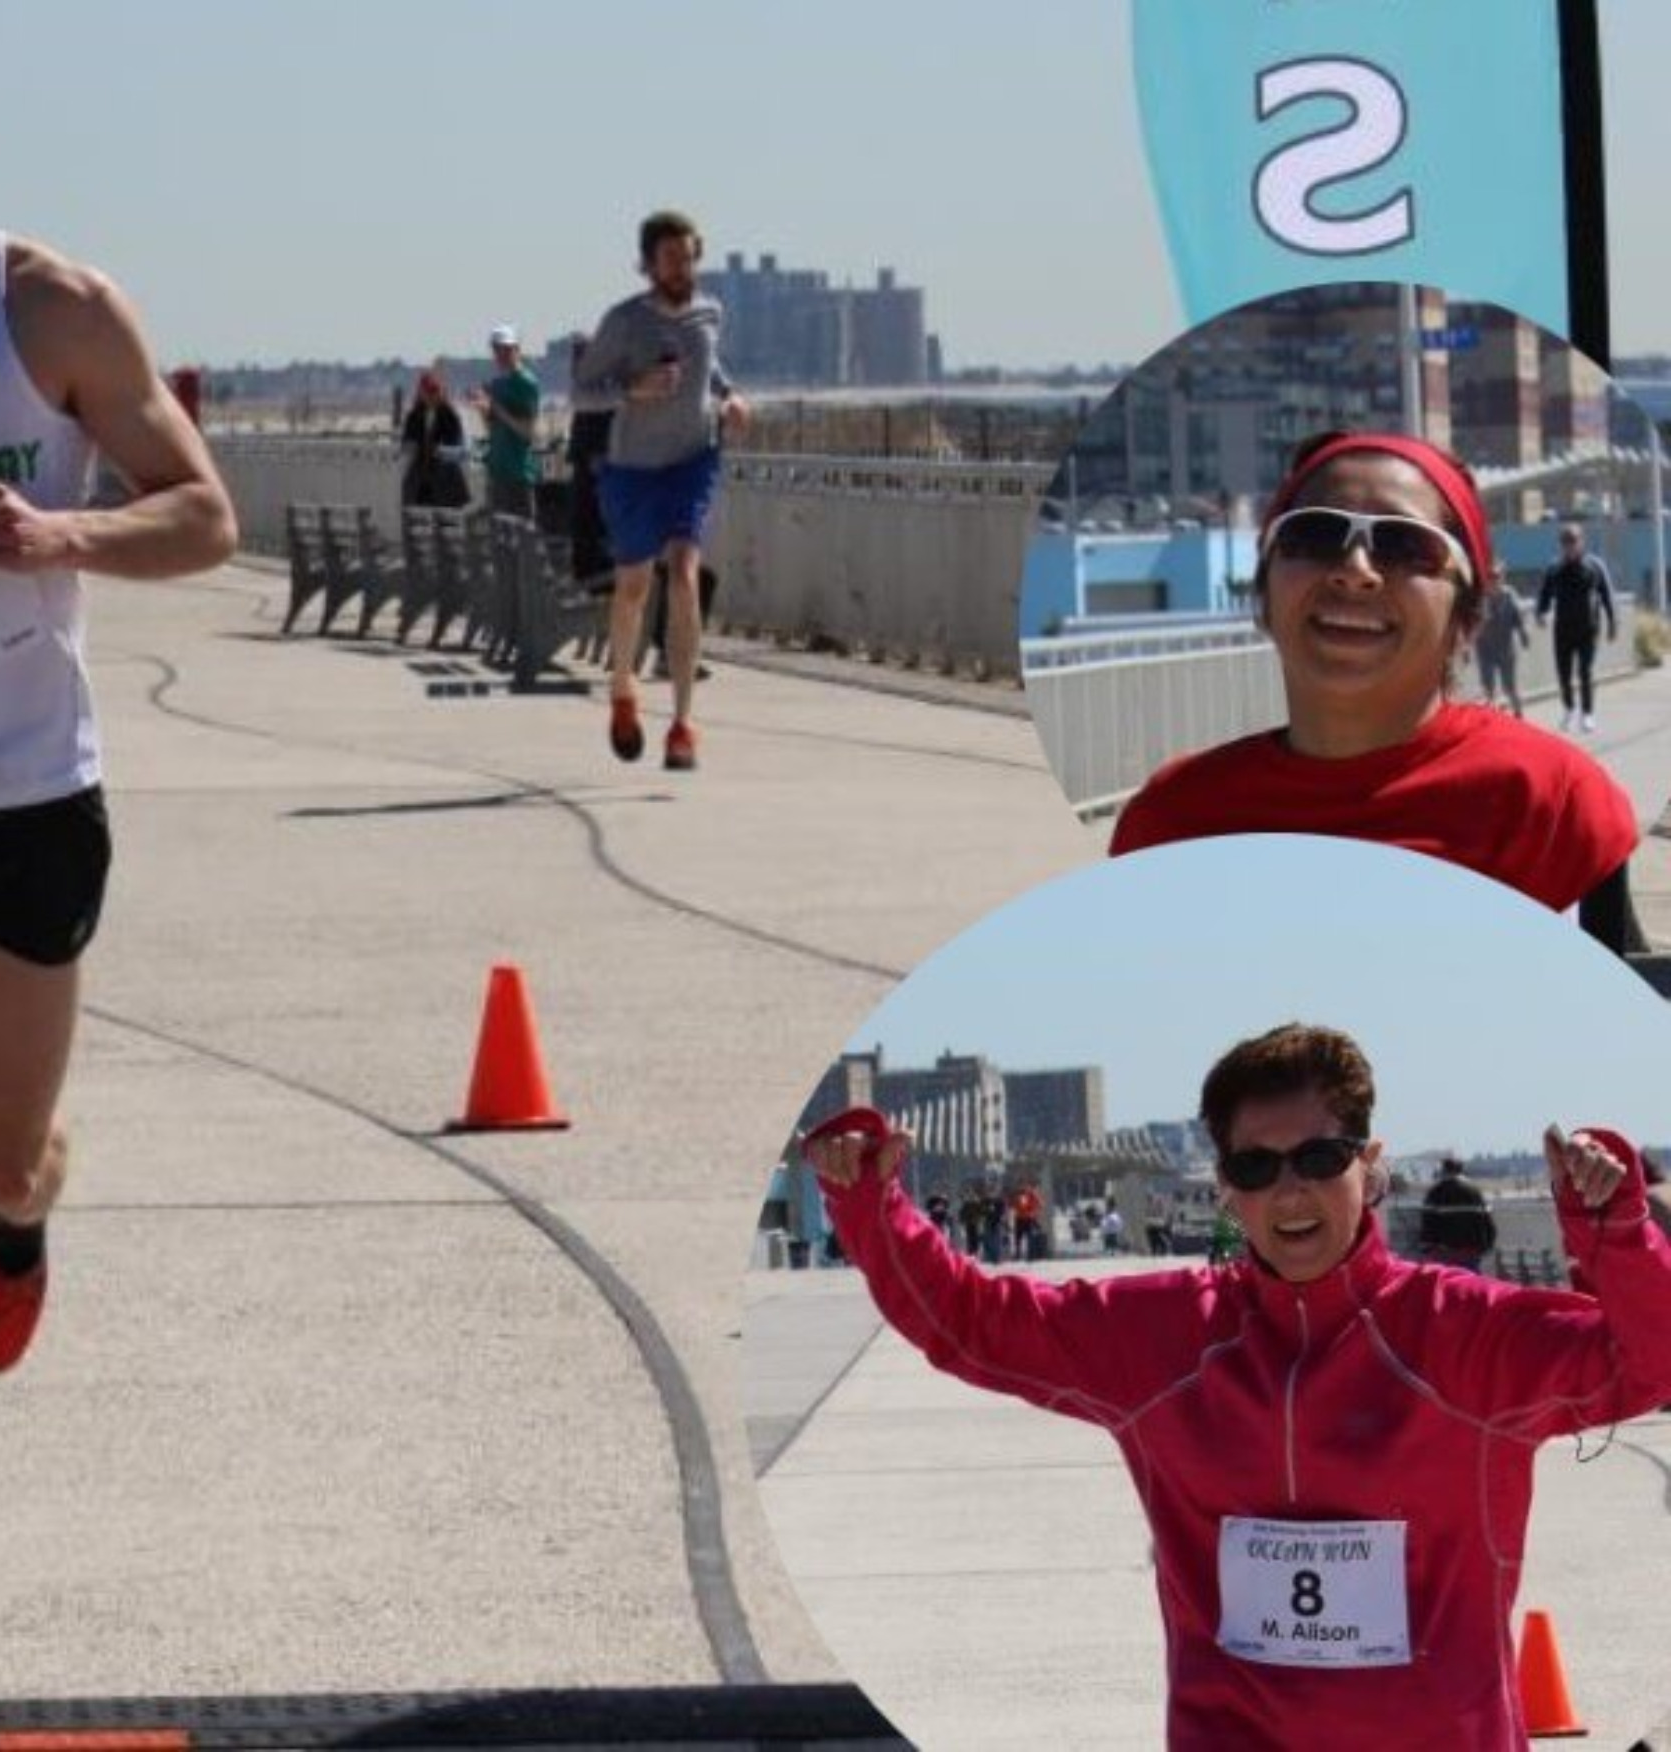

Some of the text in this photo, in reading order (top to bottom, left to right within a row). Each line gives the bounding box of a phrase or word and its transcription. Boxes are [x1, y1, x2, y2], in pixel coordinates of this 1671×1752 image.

[1290, 1569, 1324, 1617] 8
[1261, 1619, 1360, 1642] M. Alison
